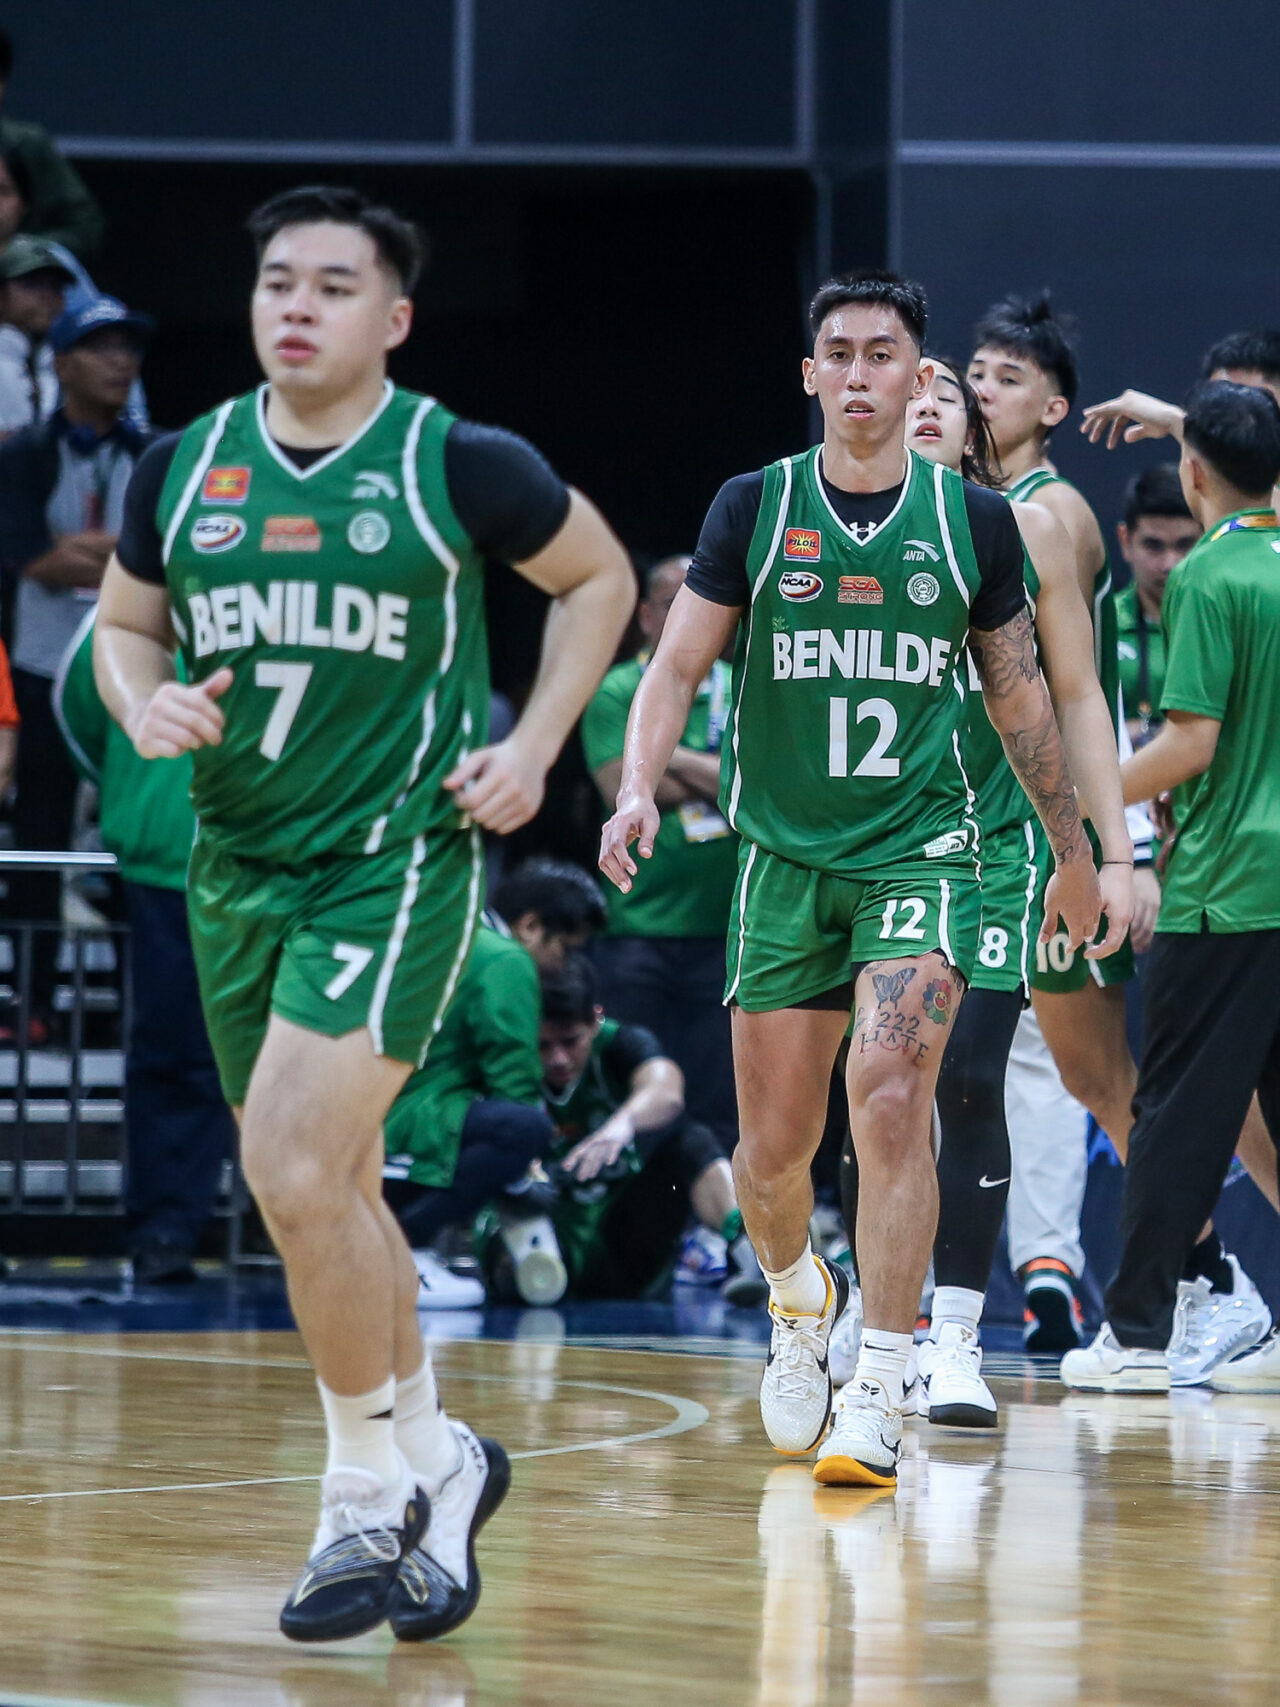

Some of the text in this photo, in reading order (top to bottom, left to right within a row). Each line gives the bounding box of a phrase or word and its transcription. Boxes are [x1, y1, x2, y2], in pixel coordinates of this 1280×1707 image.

[903, 550, 925, 562] ANTA
[780, 578, 811, 587] NCAA
[188, 578, 410, 661] BENILDE
[772, 628, 951, 687] BENILDE
[255, 662, 313, 761] 7
[829, 697, 900, 777] 12
[879, 897, 926, 939] 12
[979, 926, 1008, 968] 8
[1036, 932, 1074, 973] 10
[324, 942, 374, 1000] 7
[877, 1011, 920, 1035] 222
